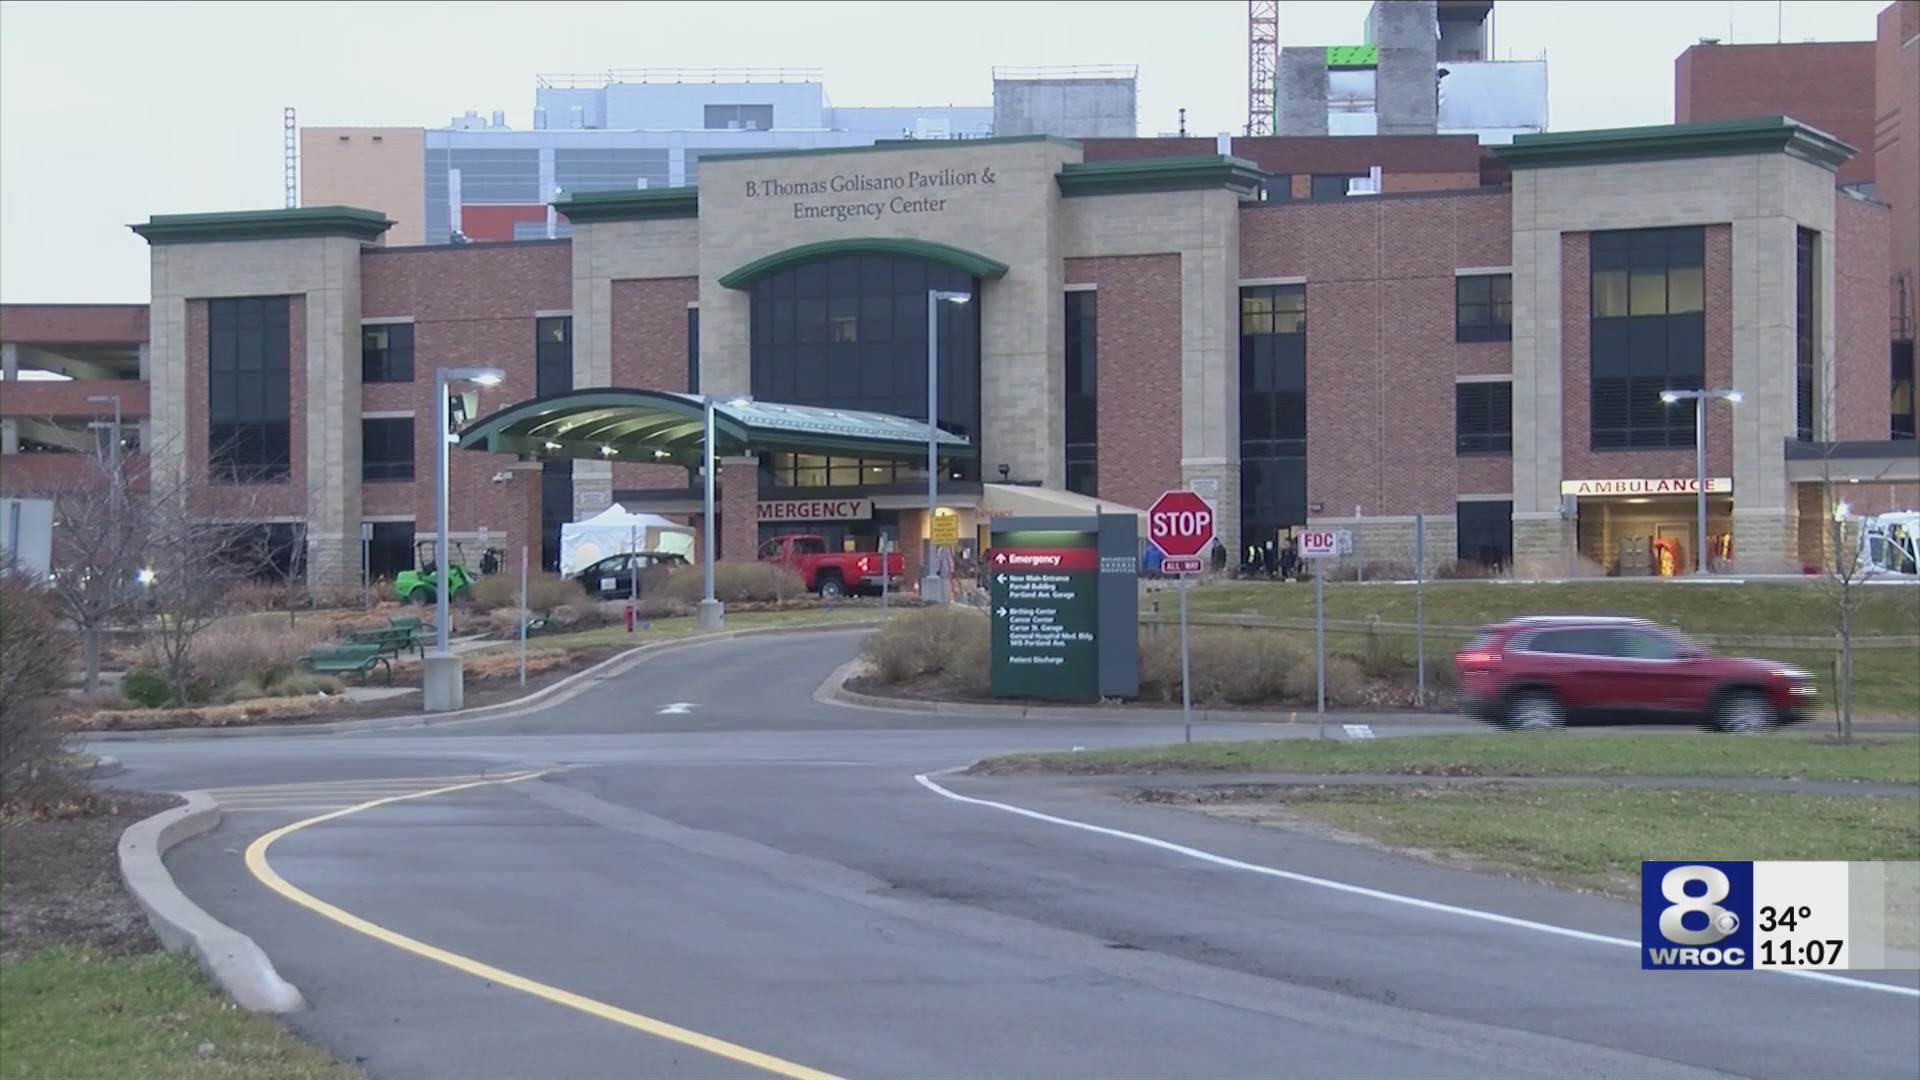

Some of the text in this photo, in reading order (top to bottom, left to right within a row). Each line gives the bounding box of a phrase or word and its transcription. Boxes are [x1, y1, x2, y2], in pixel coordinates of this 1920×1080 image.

[830, 174, 905, 194] Golisano
[908, 169, 977, 189] Pavilion
[981, 166, 996, 184] &
[793, 196, 946, 222] Emergency Center
[1578, 479, 1716, 493] AMBULANCE
[757, 501, 861, 519] MERGENCY
[1152, 511, 1211, 537] STOP
[1304, 533, 1333, 547] FDC
[1008, 553, 1062, 566] Emergency
[1165, 561, 1199, 570] ALL WAY
[1031, 583, 1057, 591] Building
[1052, 591, 1076, 600] Garage
[1009, 608, 1034, 616] Birthing
[1040, 624, 1064, 633] Garage
[1034, 632, 1060, 640] Hospital
[1033, 656, 1064, 665] Discharge
